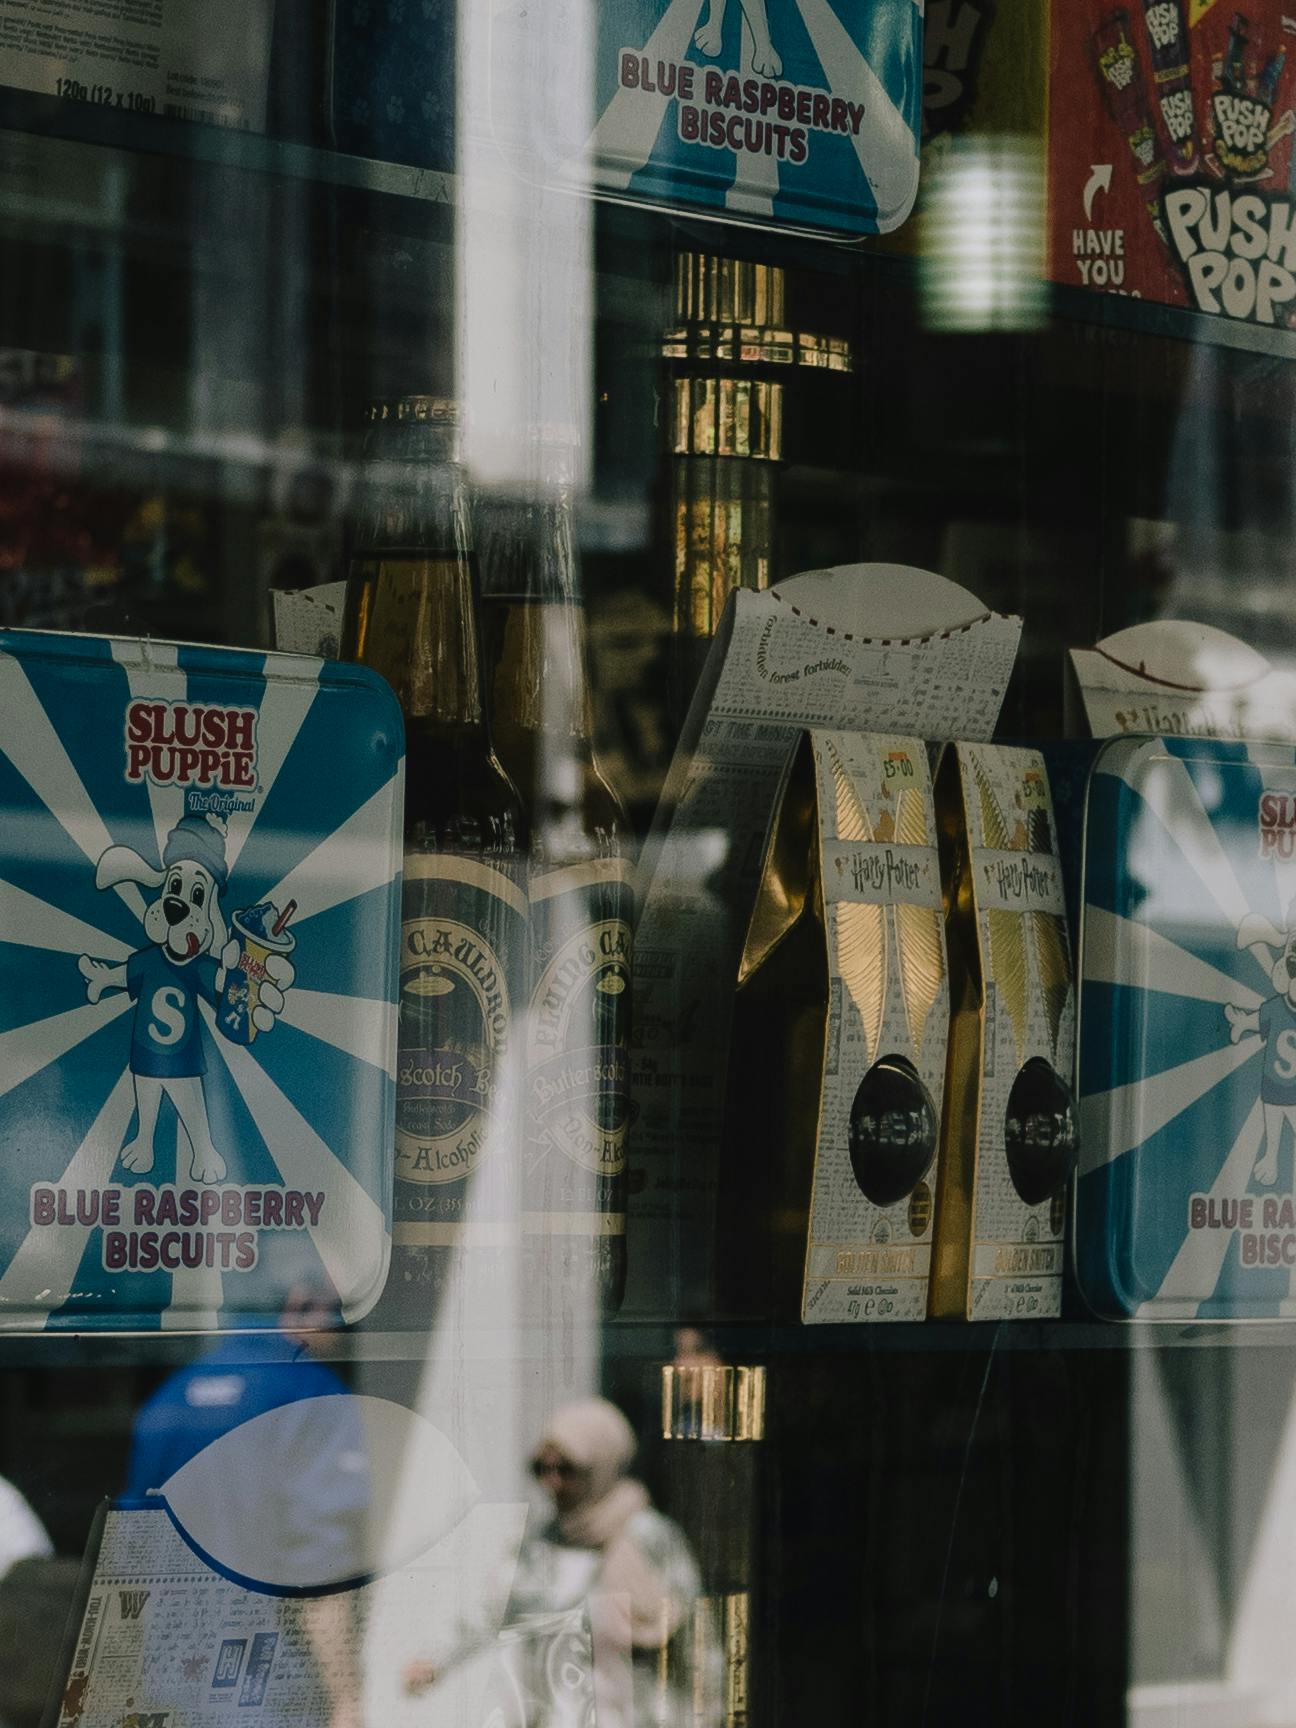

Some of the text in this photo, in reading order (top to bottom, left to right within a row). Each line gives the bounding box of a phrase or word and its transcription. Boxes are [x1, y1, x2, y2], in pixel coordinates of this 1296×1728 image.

[1145, 2, 1179, 30] PUSH
[1151, 22, 1179, 51] POP
[621, 53, 867, 137] BLUE RASPBERRY
[1159, 89, 1194, 121] PUSH
[1213, 94, 1271, 132] PUSH
[680, 105, 809, 162] BISCUITS
[1165, 113, 1193, 144] POP
[1221, 121, 1268, 153] POP
[1072, 229, 1125, 256] HAVE
[1076, 259, 1125, 286] YOU
[128, 705, 257, 752] SLUSH
[188, 791, 256, 815] The Original
[852, 849, 921, 896] Harry Potter
[995, 857, 1051, 901] Harry Potter
[148, 987, 187, 1045] S
[34, 1188, 326, 1228] BLUE RASPBERRY
[1190, 1196, 1256, 1233] BLUE
[104, 1230, 256, 1270] BISCUITS
